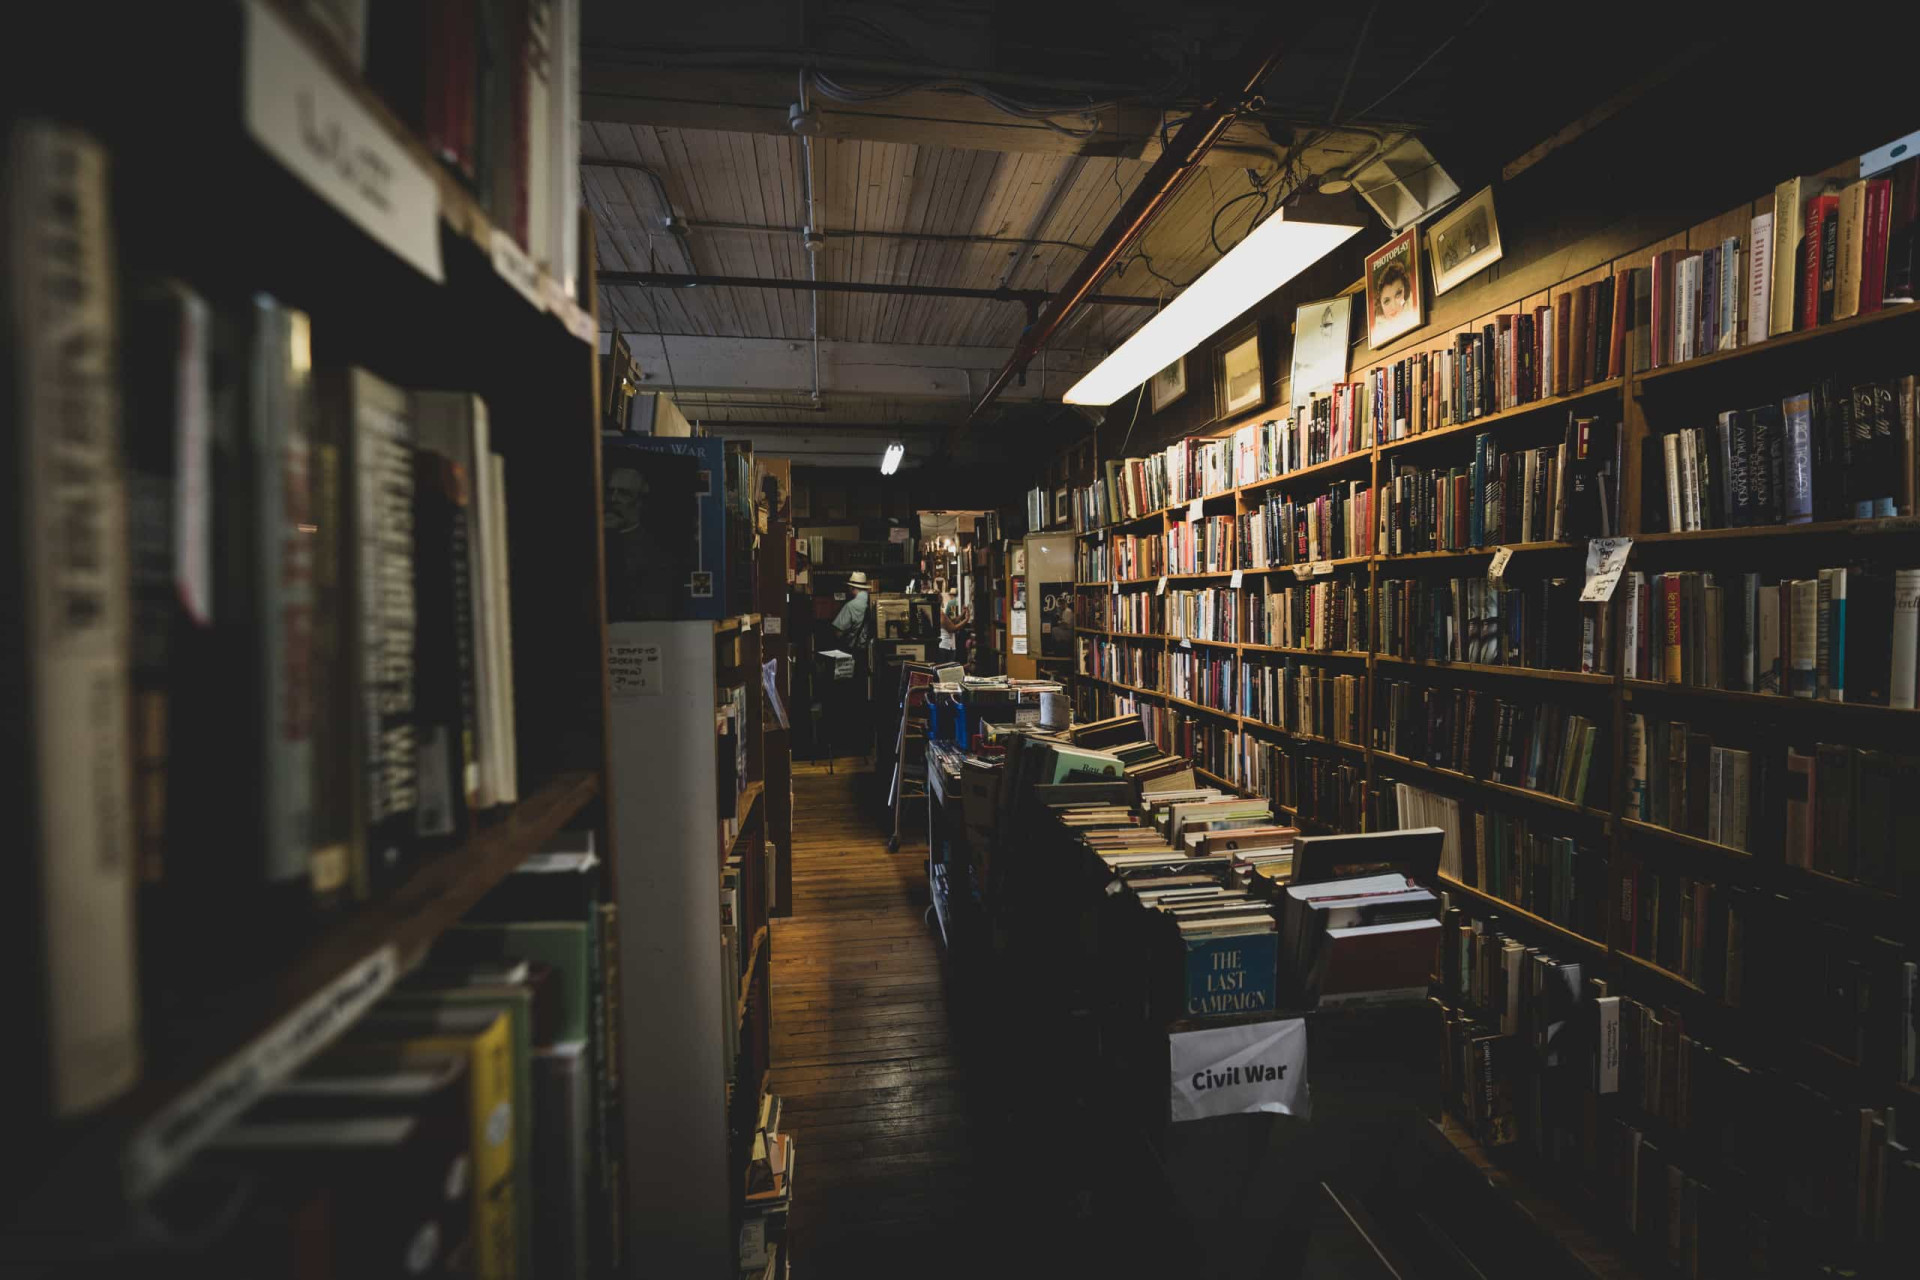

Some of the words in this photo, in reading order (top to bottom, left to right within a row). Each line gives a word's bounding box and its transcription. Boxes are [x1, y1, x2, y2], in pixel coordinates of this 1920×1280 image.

[1372, 239, 1411, 271] PHOTOPLAY
[671, 443, 707, 457] WAR
[1667, 592, 1678, 604] let
[1667, 606, 1678, 620] the
[1667, 621, 1677, 644] chips
[381, 725, 416, 813] WAR
[1211, 950, 1241, 970] THE
[1206, 970, 1247, 992] LAST
[1187, 990, 1267, 1014] CAMPAIGN
[1192, 1066, 1240, 1091] Civil
[1244, 1061, 1287, 1083] War
